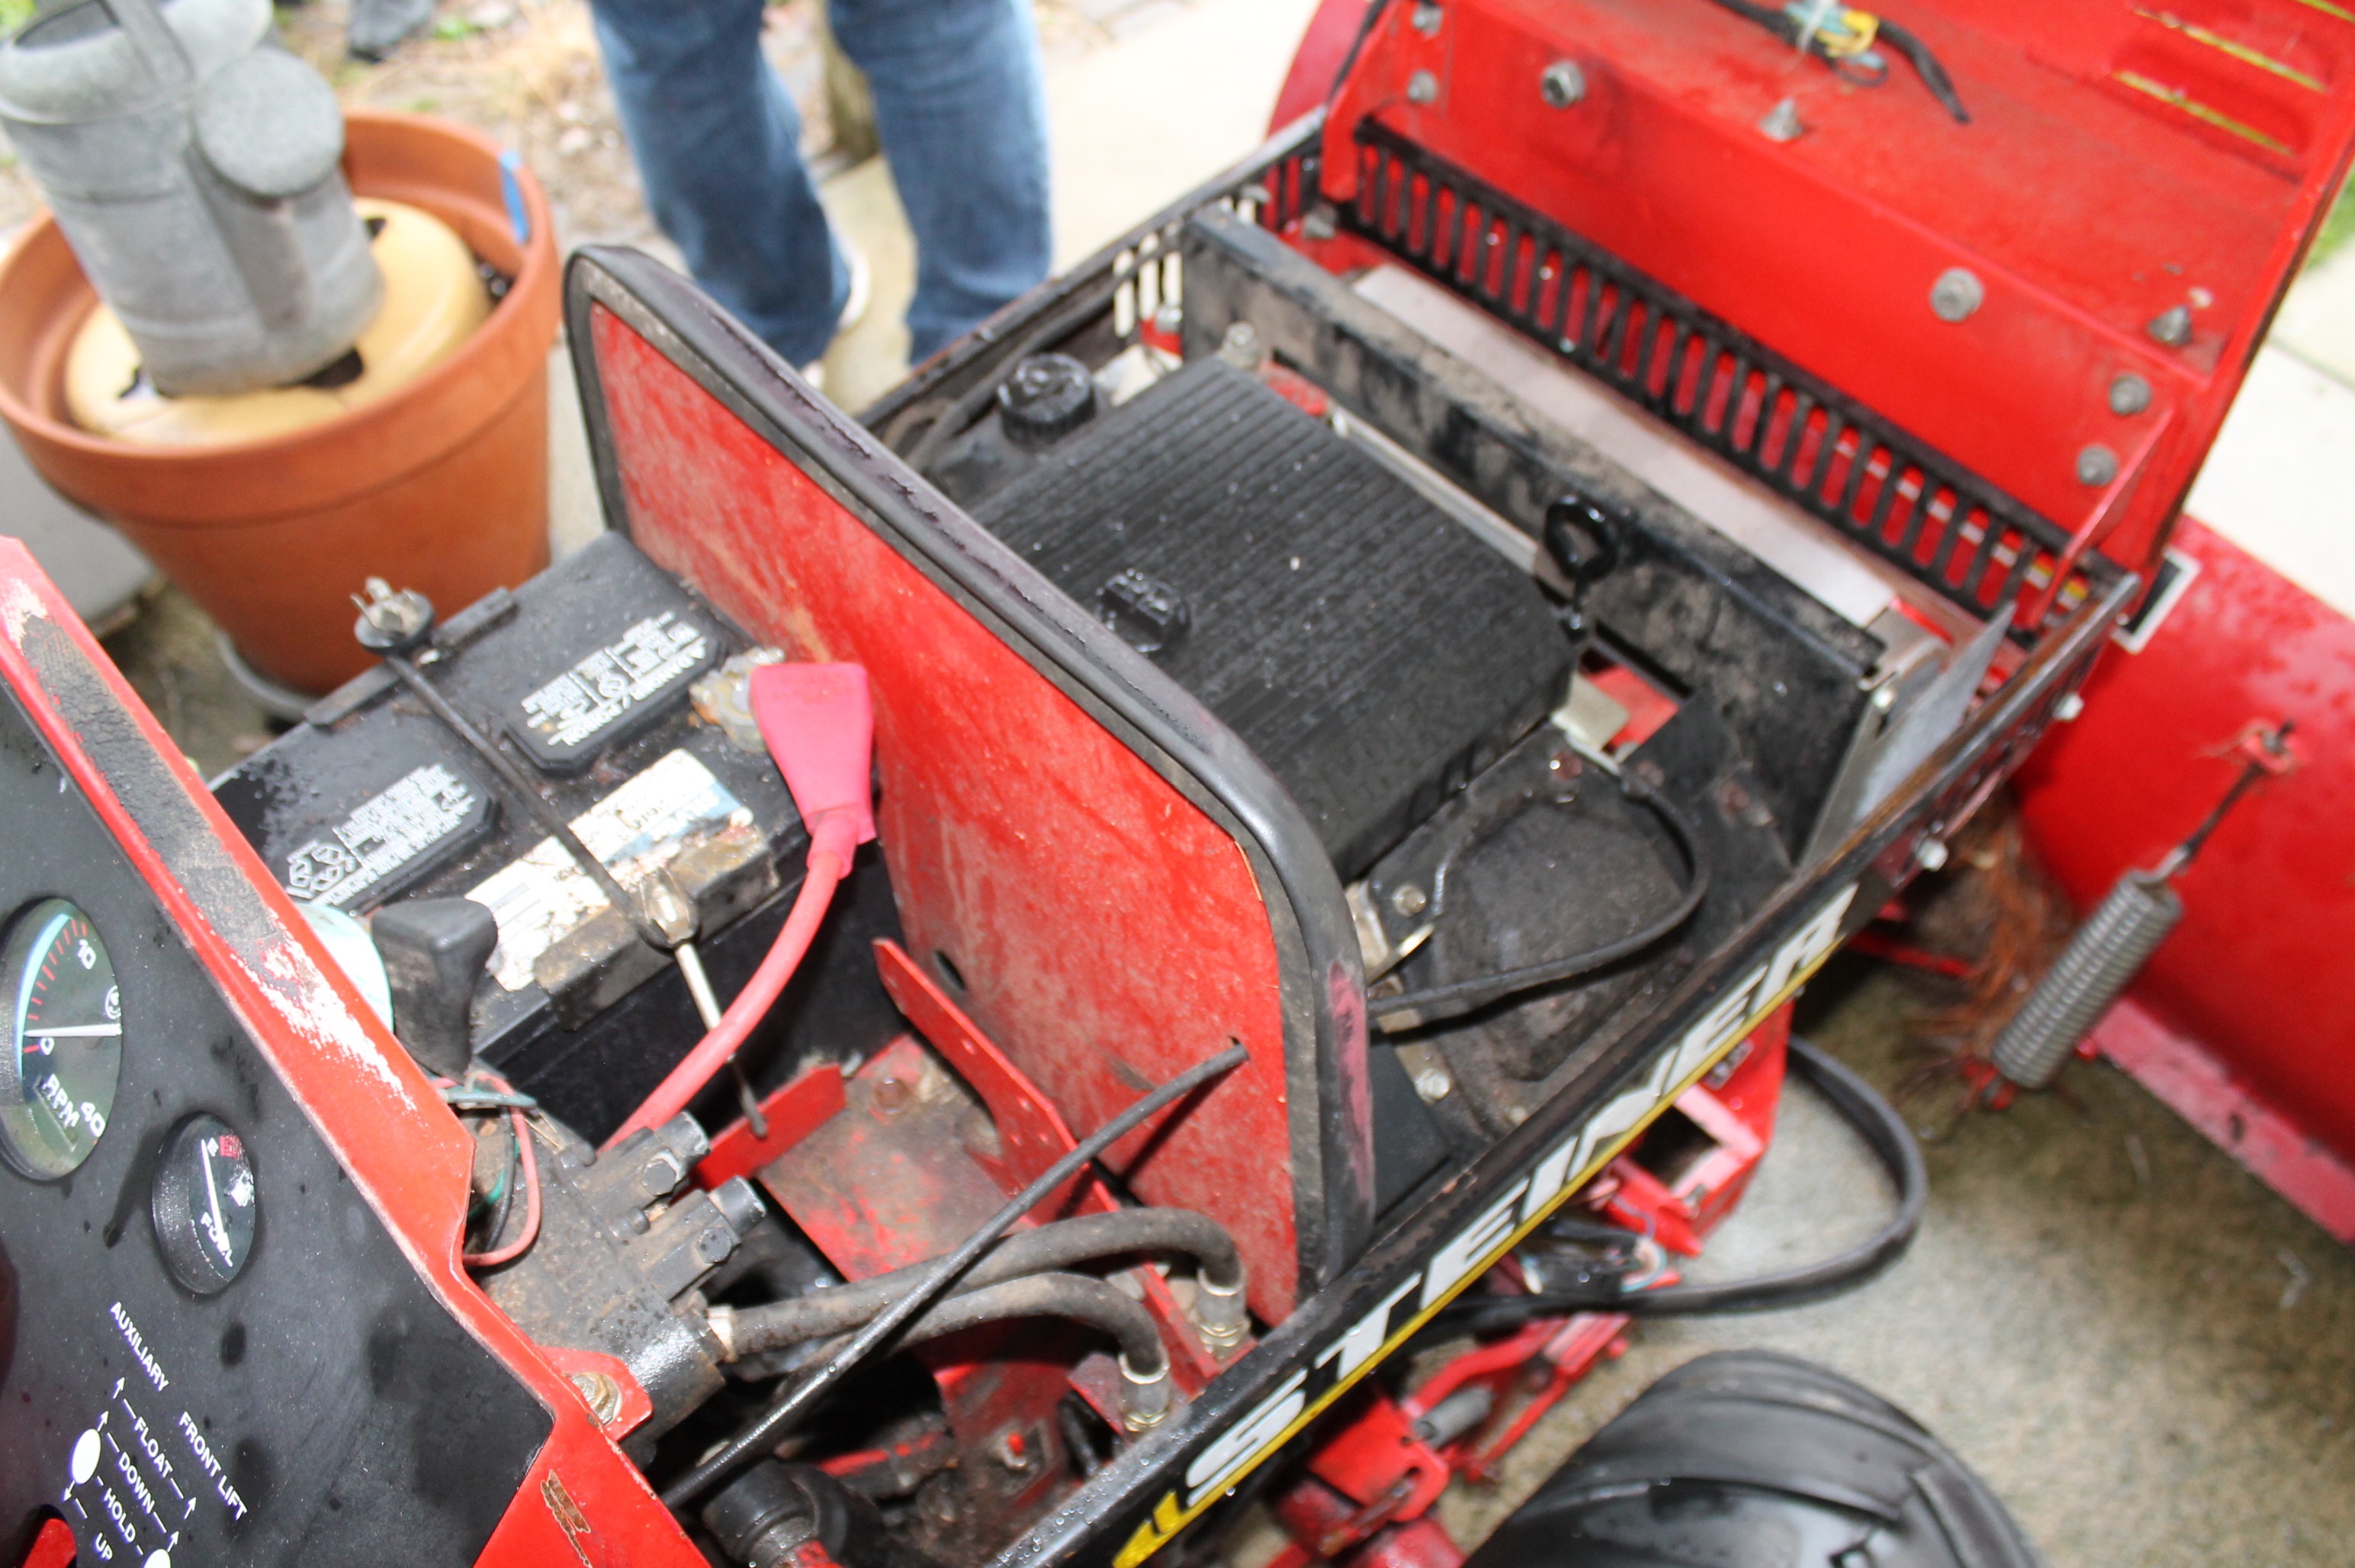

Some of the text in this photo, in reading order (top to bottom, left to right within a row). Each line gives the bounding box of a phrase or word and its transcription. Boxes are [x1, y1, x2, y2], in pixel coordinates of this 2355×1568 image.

[77, 939, 96, 970] 10
[42, 1073, 80, 1128] RPM
[80, 1101, 106, 1138] 40
[1184, 881, 1858, 1501] STEINER
[201, 1210, 233, 1268] FUL
[110, 1301, 169, 1392] AUXILIARY
[134, 1416, 173, 1478] FLOAT
[178, 1411, 248, 1521] FRONT LIFT
[118, 1452, 155, 1514] DOWN
[104, 1487, 136, 1543] HOLD
[95, 1532, 113, 1560] UP
